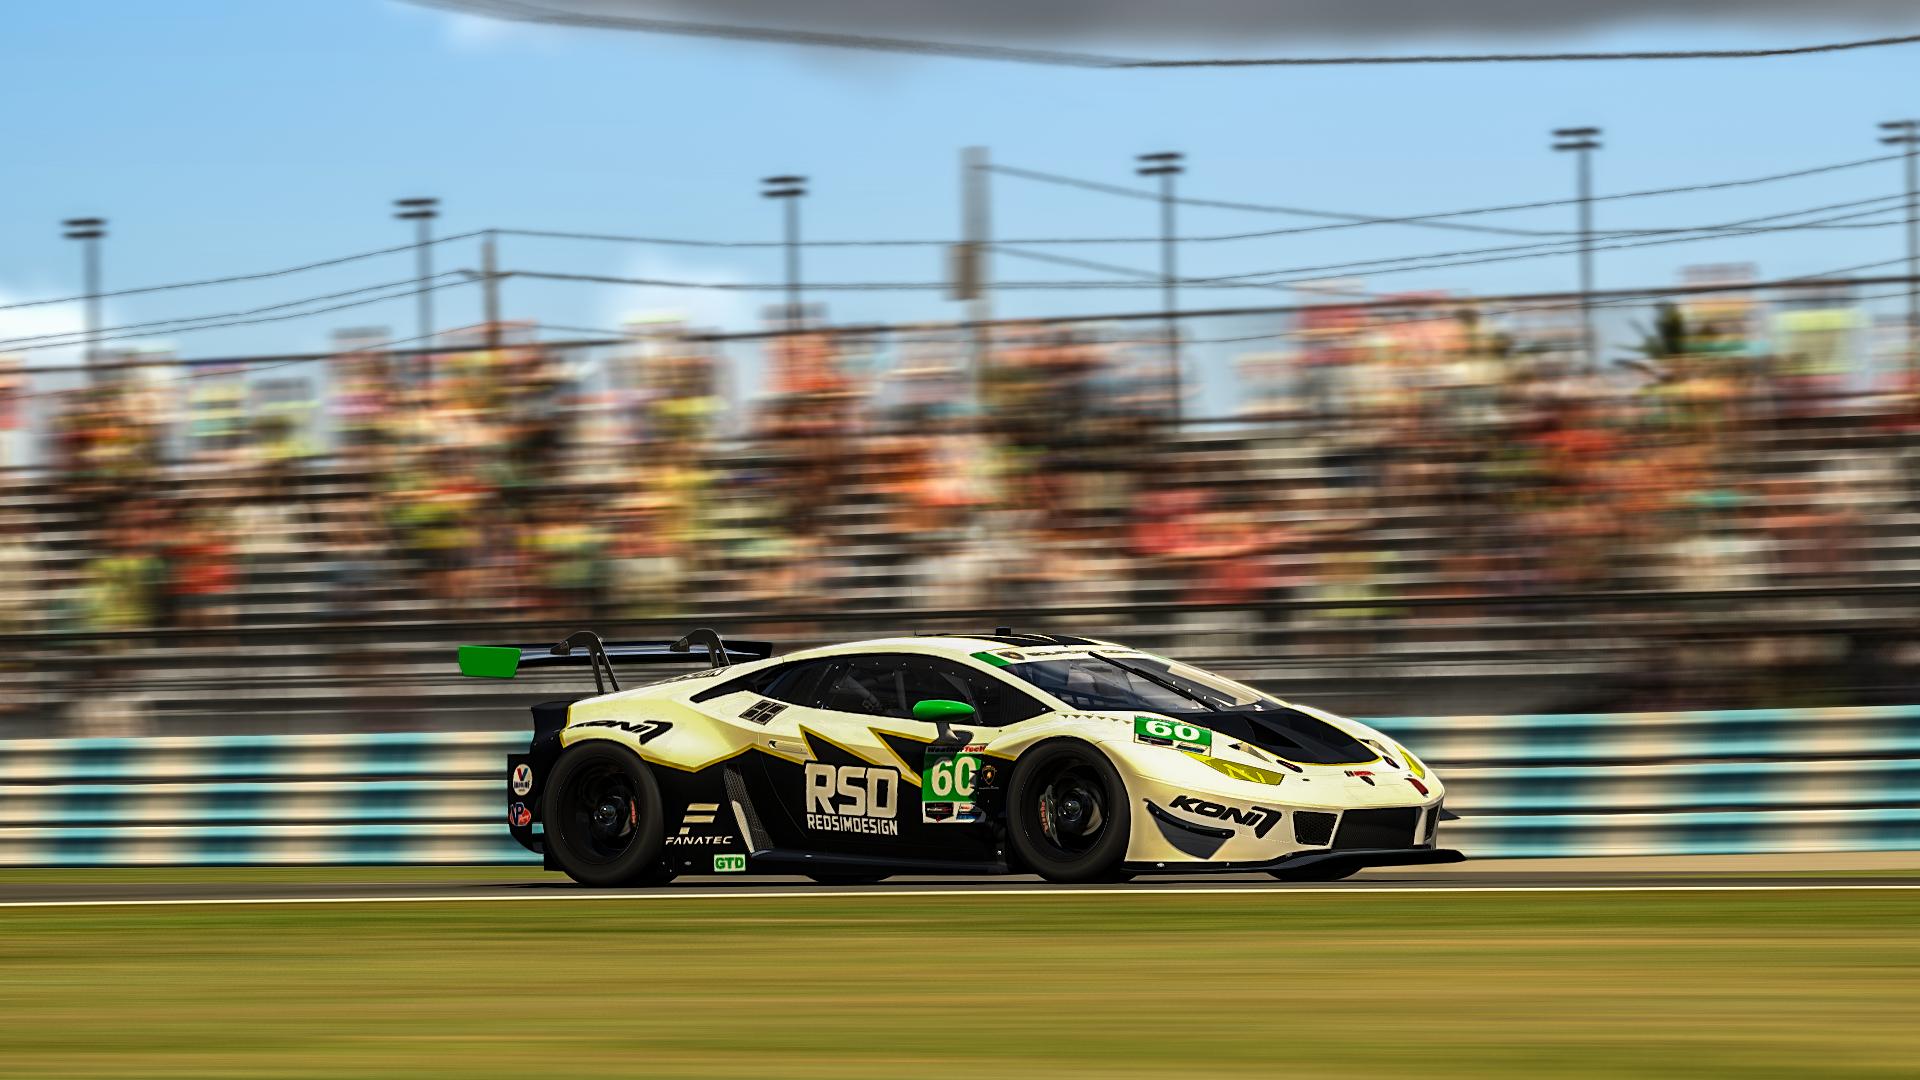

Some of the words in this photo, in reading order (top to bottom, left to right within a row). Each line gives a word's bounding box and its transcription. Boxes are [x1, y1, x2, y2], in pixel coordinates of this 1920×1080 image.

[1145, 720, 1200, 741] 60
[931, 756, 977, 797] 60
[805, 763, 898, 819] RSD
[806, 813, 898, 836] REDSIMDESIGN
[665, 836, 733, 846] FANATEC
[715, 857, 745, 869] GTD
